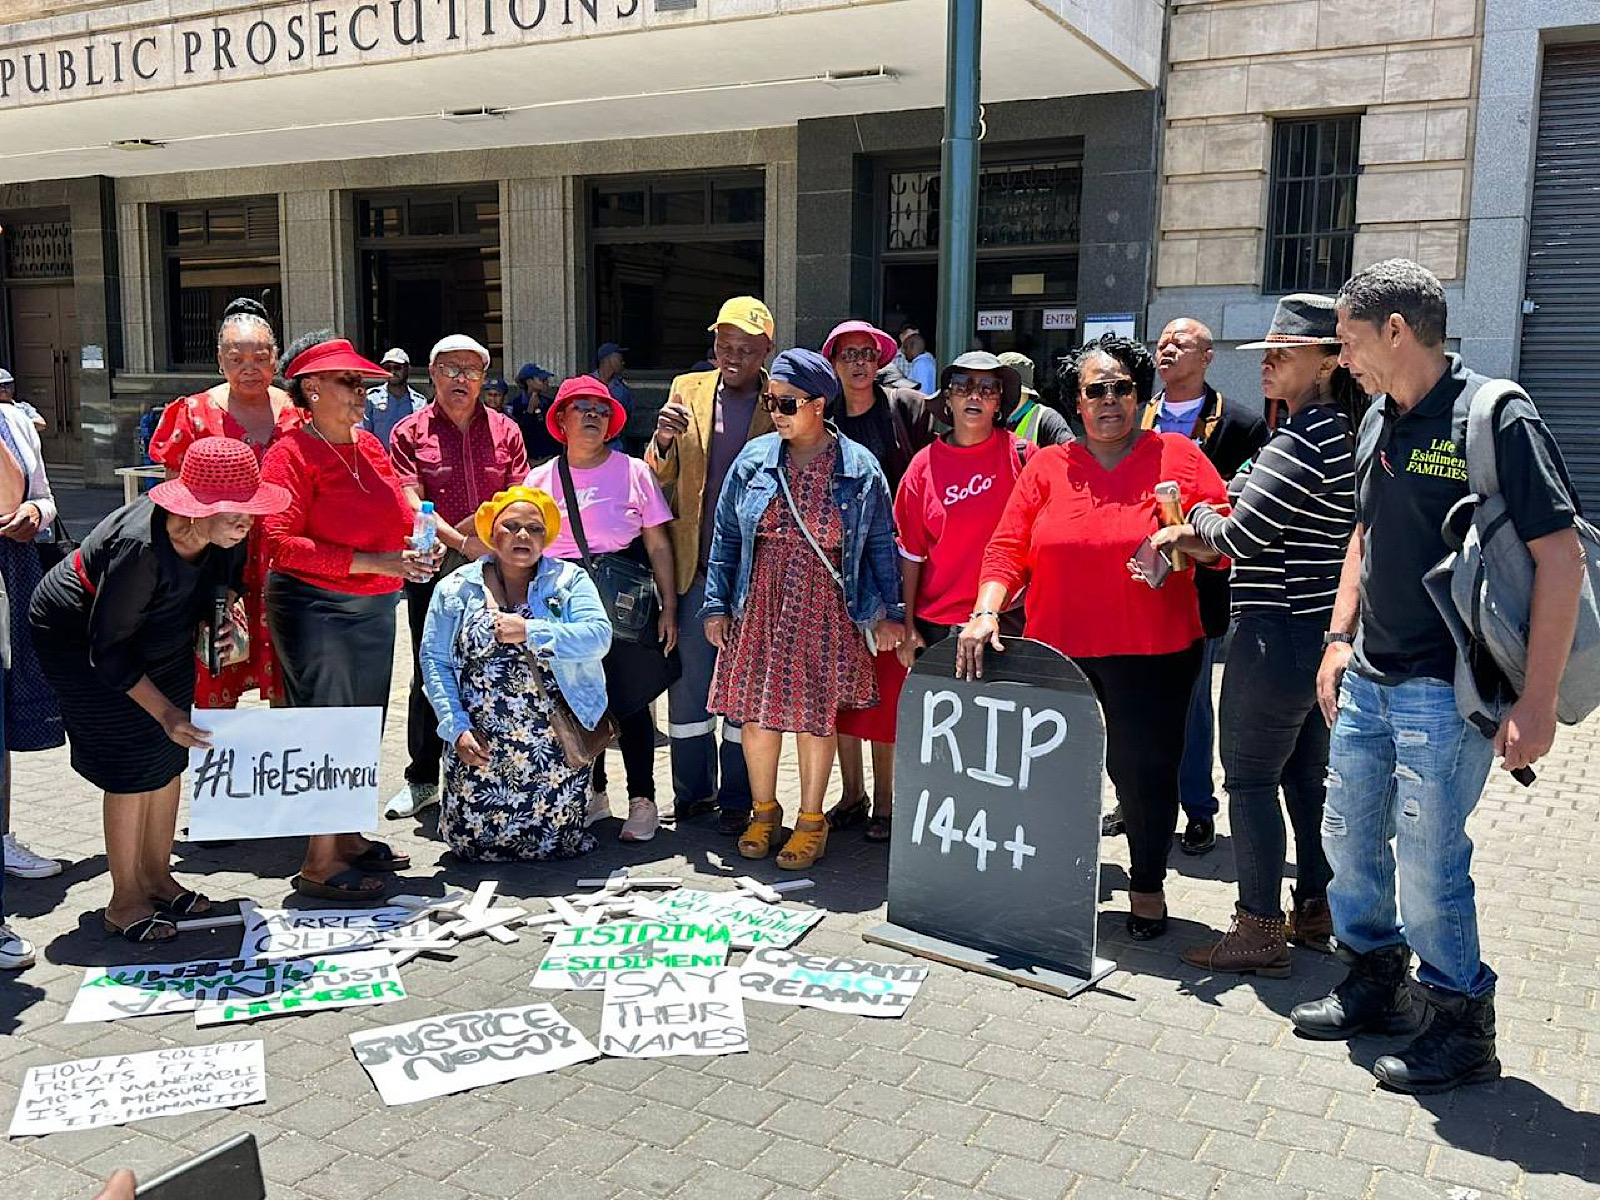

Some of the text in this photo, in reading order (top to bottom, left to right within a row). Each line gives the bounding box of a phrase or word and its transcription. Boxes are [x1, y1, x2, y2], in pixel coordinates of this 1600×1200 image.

[0, 36, 158, 97] PUBLIC
[980, 315, 1010, 326] ENTRY
[1046, 313, 1077, 325] ENTRY
[1410, 448, 1467, 469] Esidimen
[1430, 438, 1456, 454] Life
[1405, 460, 1468, 481] FAMILIES
[943, 474, 993, 505] SoCo
[920, 690, 1068, 790] RIP
[193, 748, 379, 800] #LifeEsidimeni
[911, 788, 1037, 872] 144+
[556, 923, 731, 947] ISIDIMA
[756, 947, 925, 983] QEDANI
[614, 970, 728, 998] SAY
[739, 972, 913, 1006] QEDANI
[607, 1000, 735, 1028] THEIR
[355, 1008, 559, 1065] JUSTICE
[603, 1026, 749, 1054] NAMES
[34, 1060, 102, 1082] HOW
[116, 1056, 132, 1067] A
[35, 1070, 136, 1094] TREATS
[26, 1087, 105, 1109] MOST
[26, 1105, 67, 1121] IS
[90, 1099, 109, 1109] A
[230, 1075, 258, 1089] OF
[126, 1089, 260, 1118] HUMANITY
